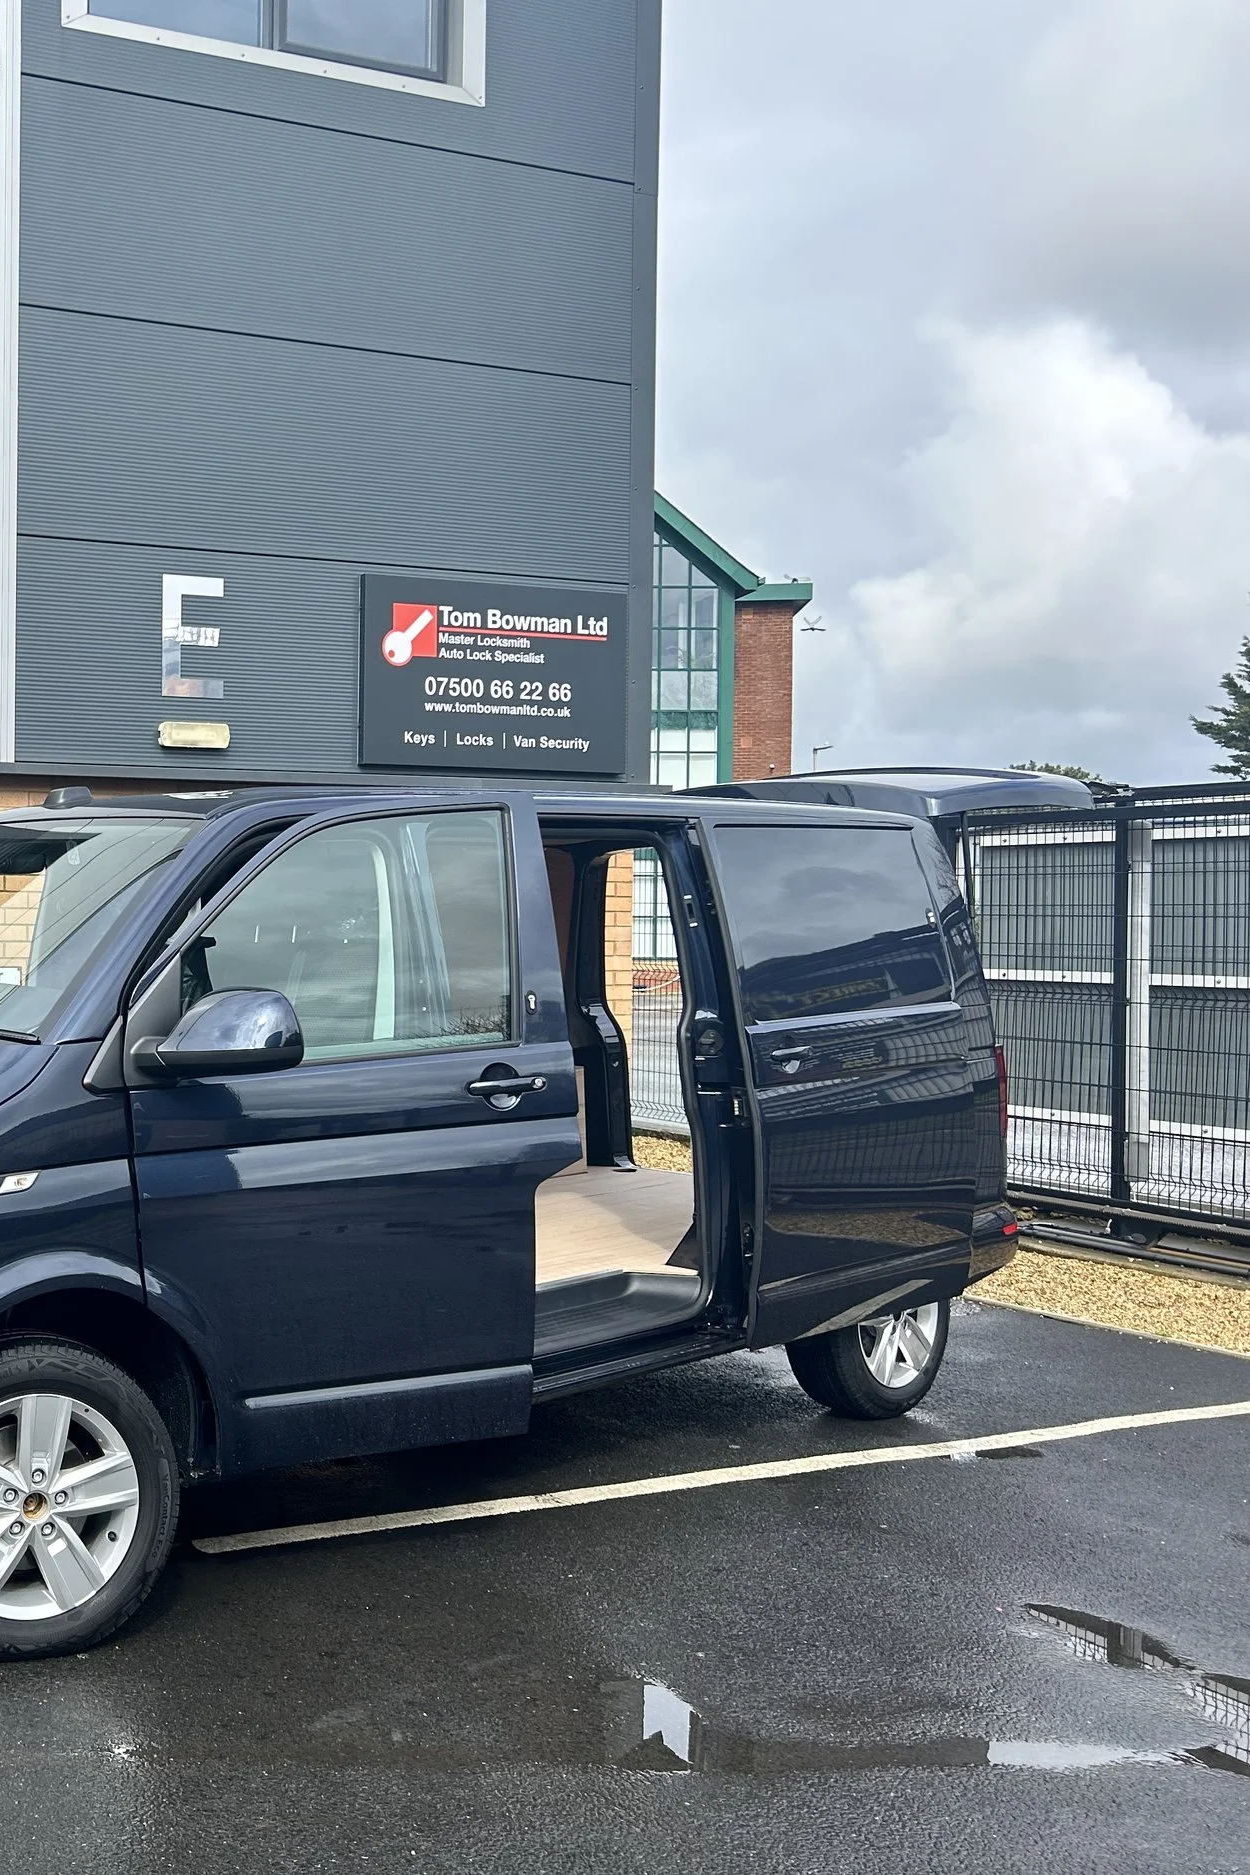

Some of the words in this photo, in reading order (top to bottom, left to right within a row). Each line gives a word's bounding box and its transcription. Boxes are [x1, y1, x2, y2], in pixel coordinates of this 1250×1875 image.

[438, 605, 481, 628] Tom
[487, 608, 572, 634] Bowman
[577, 615, 608, 636] Ltd
[161, 573, 225, 699] E
[438, 632, 476, 646] Master
[477, 634, 531, 649] Locksmith
[438, 647, 465, 660] Auto
[466, 648, 493, 661] Lock
[494, 650, 545, 664] Specialist
[424, 676, 485, 698] 07500
[490, 679, 514, 700] 66
[519, 681, 543, 701] 22
[548, 682, 572, 702] 66
[424, 702, 571, 718] www.tombowmanltd.co.uk
[404, 730, 436, 747] Keys
[456, 732, 494, 747] Locks
[513, 735, 536, 748] Van
[539, 736, 590, 752] Security
